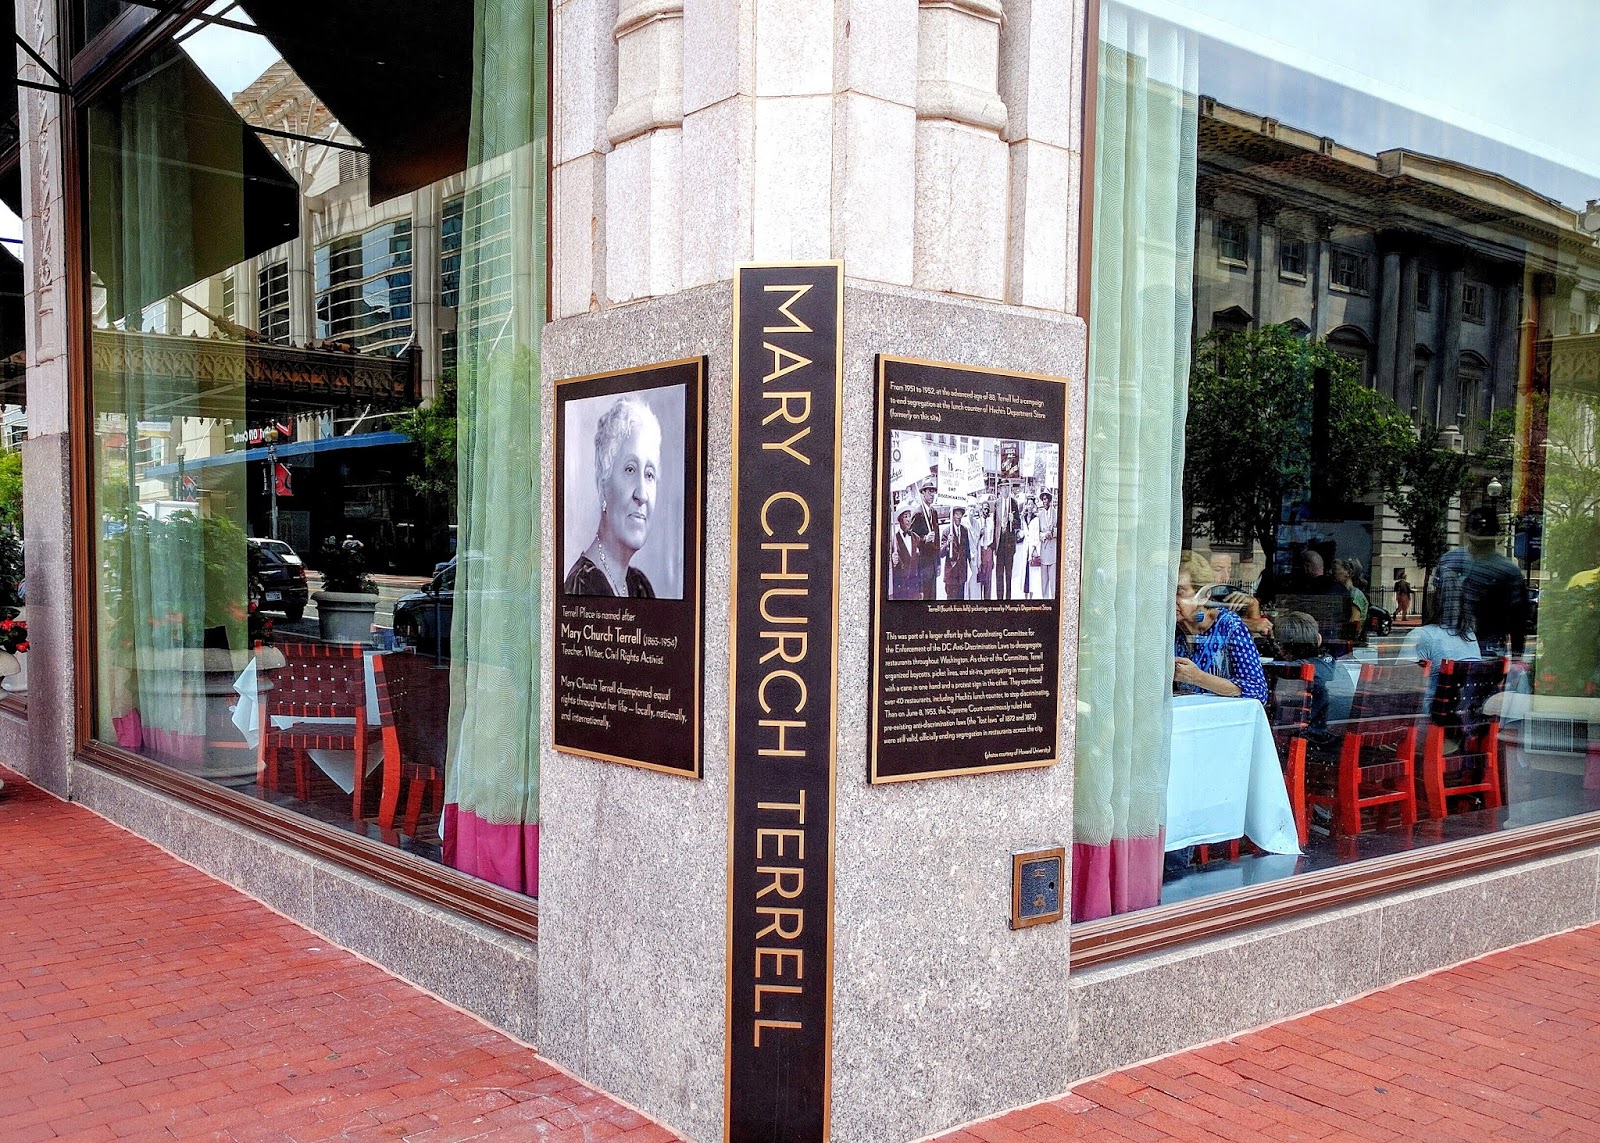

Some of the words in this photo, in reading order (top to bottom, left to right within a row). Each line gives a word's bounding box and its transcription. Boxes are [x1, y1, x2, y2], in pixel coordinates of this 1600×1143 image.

[761, 284, 815, 466] MARY
[562, 605, 578, 617] Terrell
[579, 606, 595, 618] Place
[595, 610, 601, 619] is
[601, 609, 620, 620] named
[622, 608, 636, 621] after
[561, 623, 582, 643] Mary
[583, 625, 613, 642] Church
[614, 627, 642, 644] Terrell
[757, 491, 811, 758] CHURCH
[604, 647, 619, 660] Civil
[620, 649, 640, 664] Rights
[640, 651, 664, 664] Activist
[560, 675, 576, 688] Mary
[576, 677, 598, 690] Church
[598, 679, 616, 693] Terrell
[616, 682, 652, 698] championed
[653, 688, 671, 702] equal
[560, 692, 576, 706] rights
[576, 694, 607, 710] throughout
[607, 698, 617, 711] her
[618, 700, 627, 713] life
[560, 710, 571, 721] and
[754, 789, 807, 1049] TERRELL
